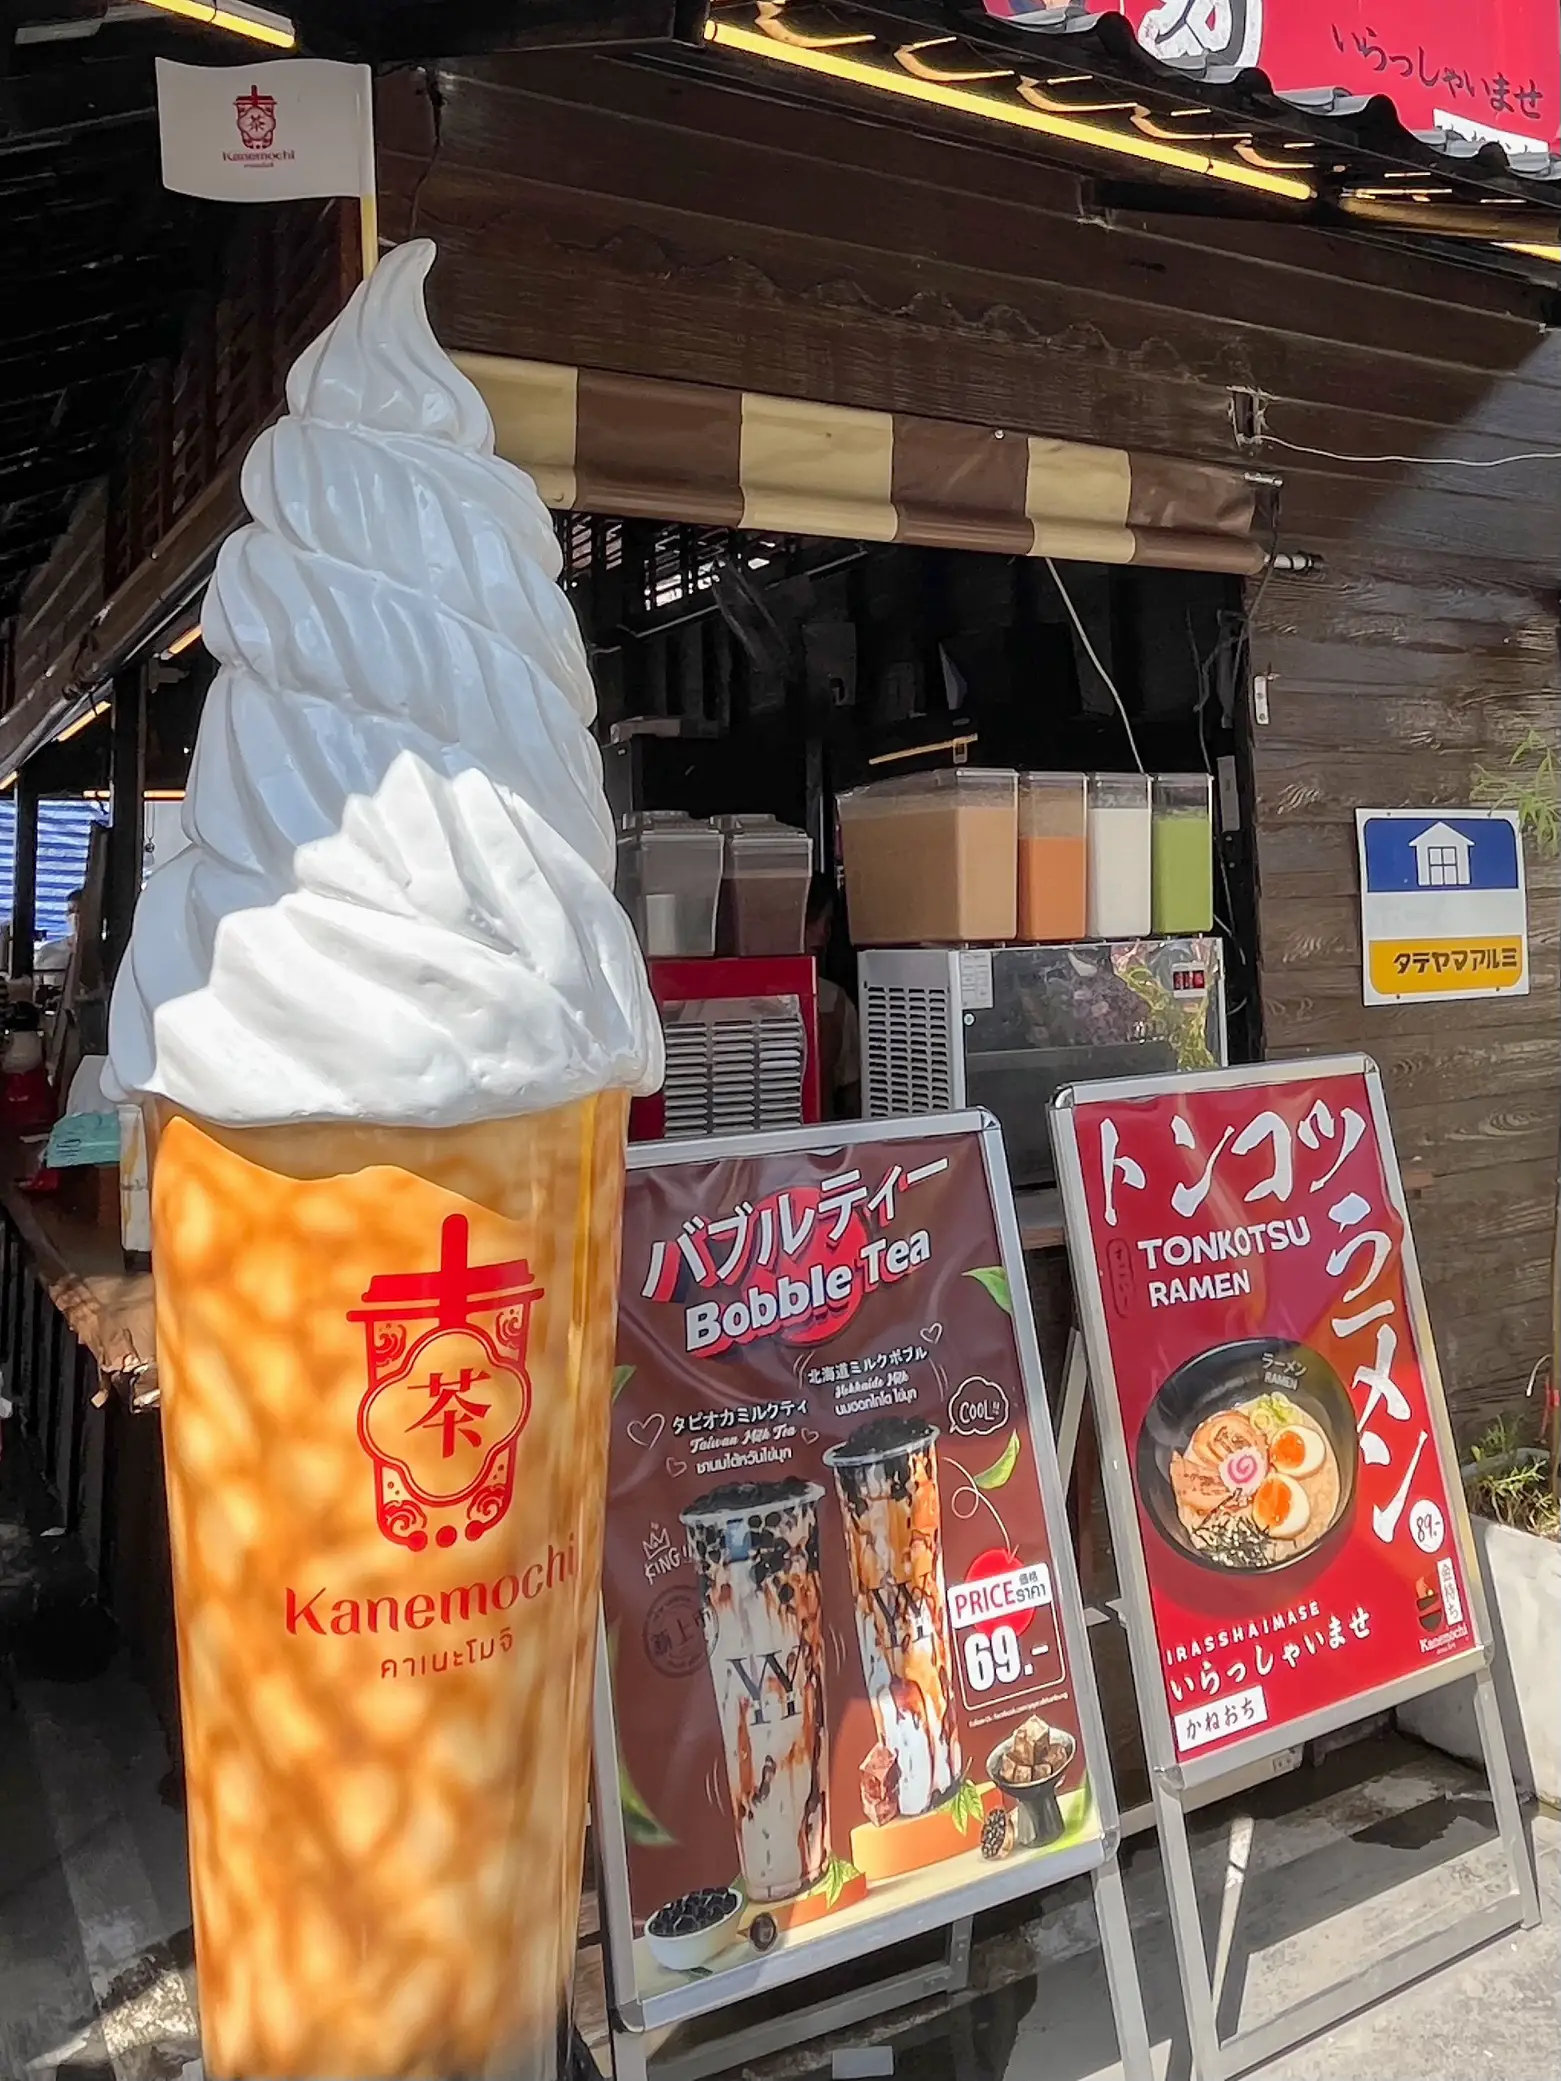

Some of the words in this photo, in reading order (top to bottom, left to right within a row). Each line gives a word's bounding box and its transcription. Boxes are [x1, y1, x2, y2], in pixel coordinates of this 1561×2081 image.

[1331, 23, 1544, 120] いらっしゃいませ
[222, 149, 296, 162] Kanemochi
[1392, 947, 1518, 975] タテヤマアルミ
[1100, 1099, 1367, 1227] トンコツ
[640, 1156, 950, 1299] バブルティー
[1137, 1215, 1312, 1271] TONKOTSU
[685, 1261, 855, 1353] Bobble
[859, 1228, 932, 1284] Tea
[1148, 1268, 1252, 1309] RAMEN
[1262, 1352, 1308, 1377] ラーメン
[1264, 1371, 1298, 1391] RAMEN
[1325, 1191, 1429, 1545] ラーメン
[404, 1367, 492, 1460] 茶
[672, 1400, 809, 1435] タピオカミルクティ
[690, 1433, 739, 1454] Taiwan
[741, 1427, 772, 1446] Milk
[772, 1423, 797, 1441] Tea
[284, 1532, 577, 1637] Kanemochi
[954, 1579, 1018, 1620] PRICE
[1016, 1583, 1048, 1603] ราคา
[380, 1626, 514, 1679] คาเนะโมจิ
[1165, 1599, 1322, 1666] IRASSHAIMASE
[1169, 1606, 1372, 1702] いらっしゃいませ
